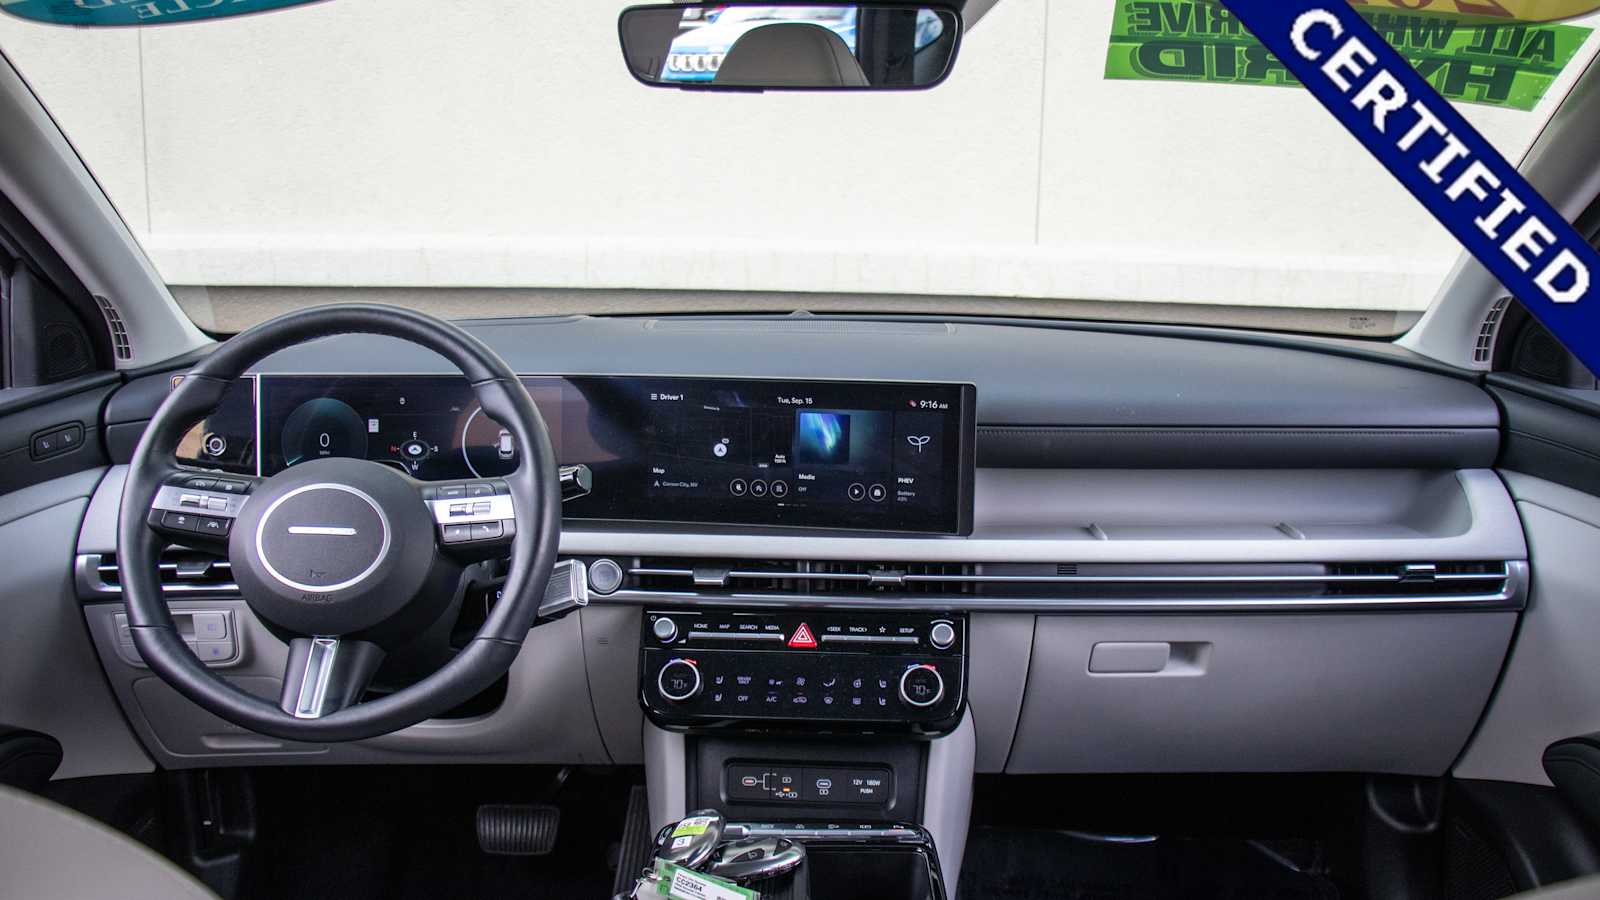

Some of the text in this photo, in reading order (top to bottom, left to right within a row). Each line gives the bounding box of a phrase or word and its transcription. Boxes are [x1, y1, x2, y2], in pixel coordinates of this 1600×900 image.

[660, 393, 679, 401] Driver
[777, 396, 791, 404] Tue,
[791, 397, 804, 405] Sep.
[919, 400, 938, 409] 9:16
[319, 432, 330, 448] 0
[652, 467, 665, 475] Map
